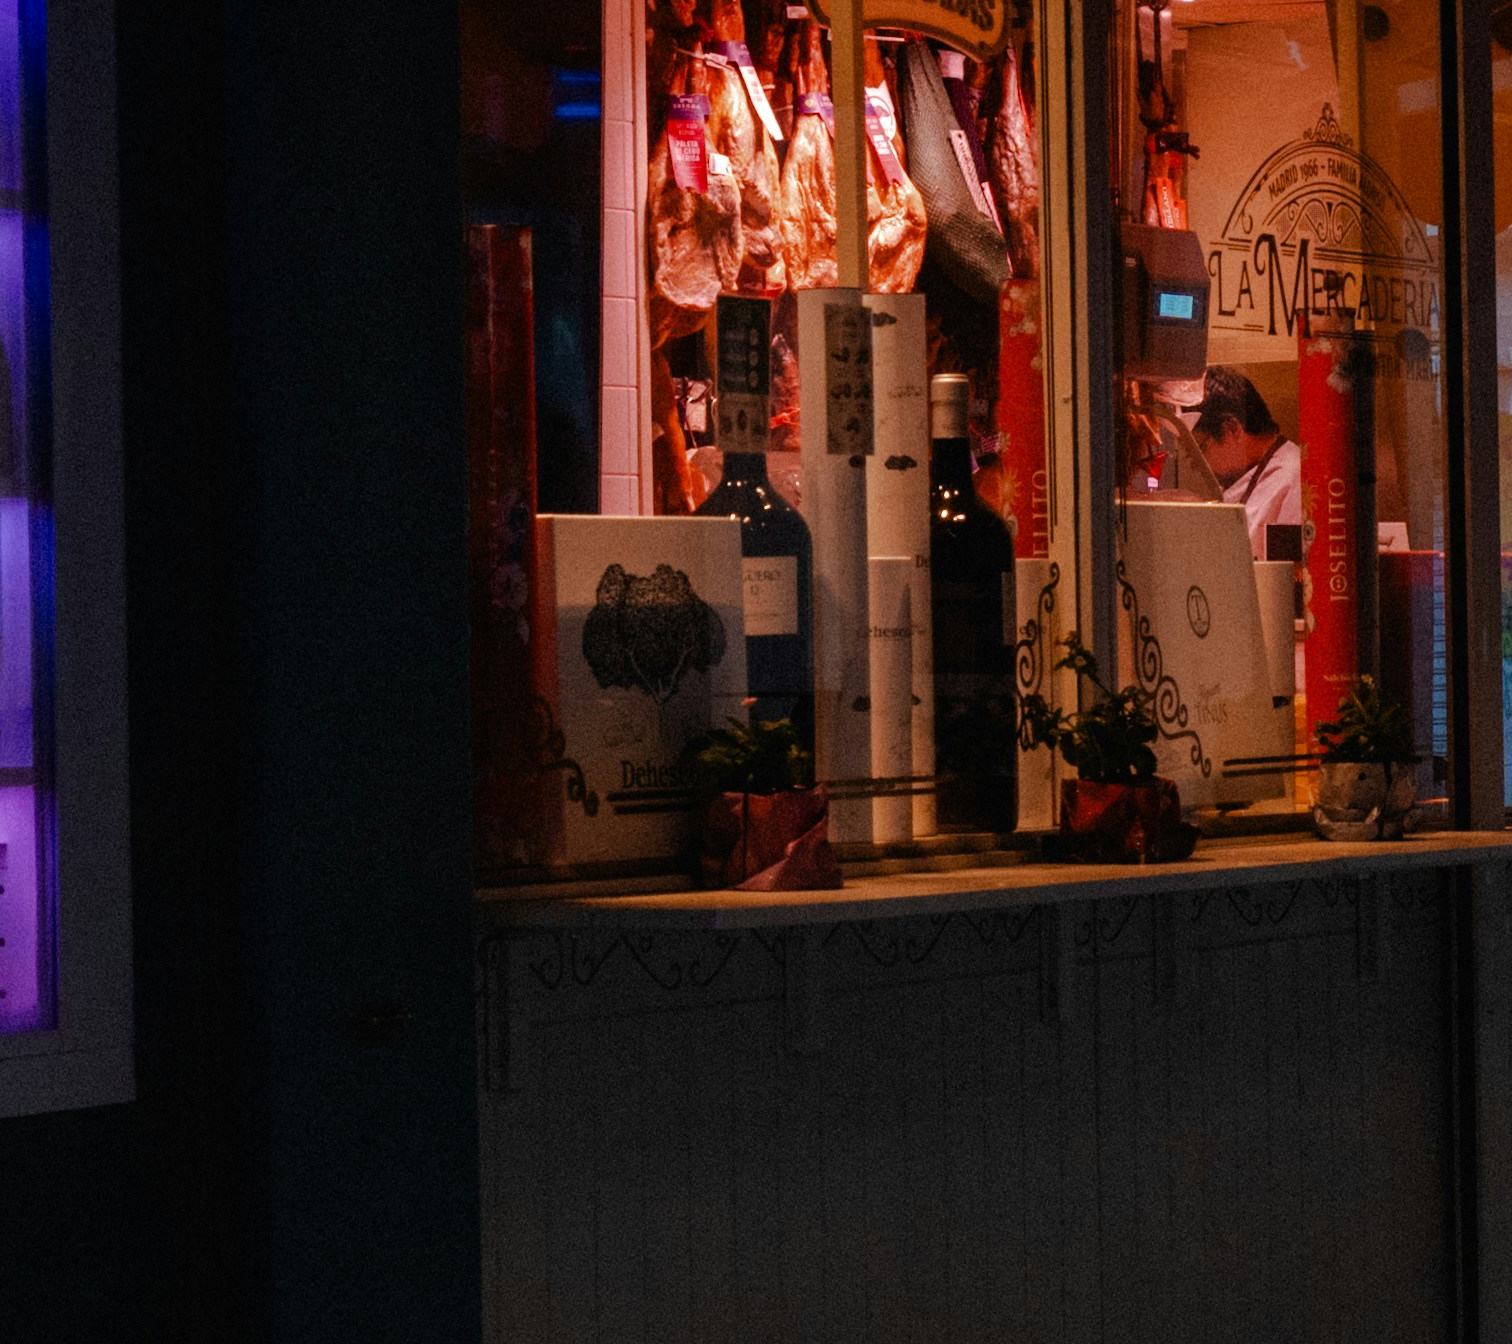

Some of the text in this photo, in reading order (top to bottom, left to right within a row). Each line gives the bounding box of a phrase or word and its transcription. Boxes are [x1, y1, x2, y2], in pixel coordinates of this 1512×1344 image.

[1299, 158, 1319, 182] 1966
[1208, 232, 1439, 340] LA MERCADERÍA
[1327, 476, 1351, 603] JOSELITO
